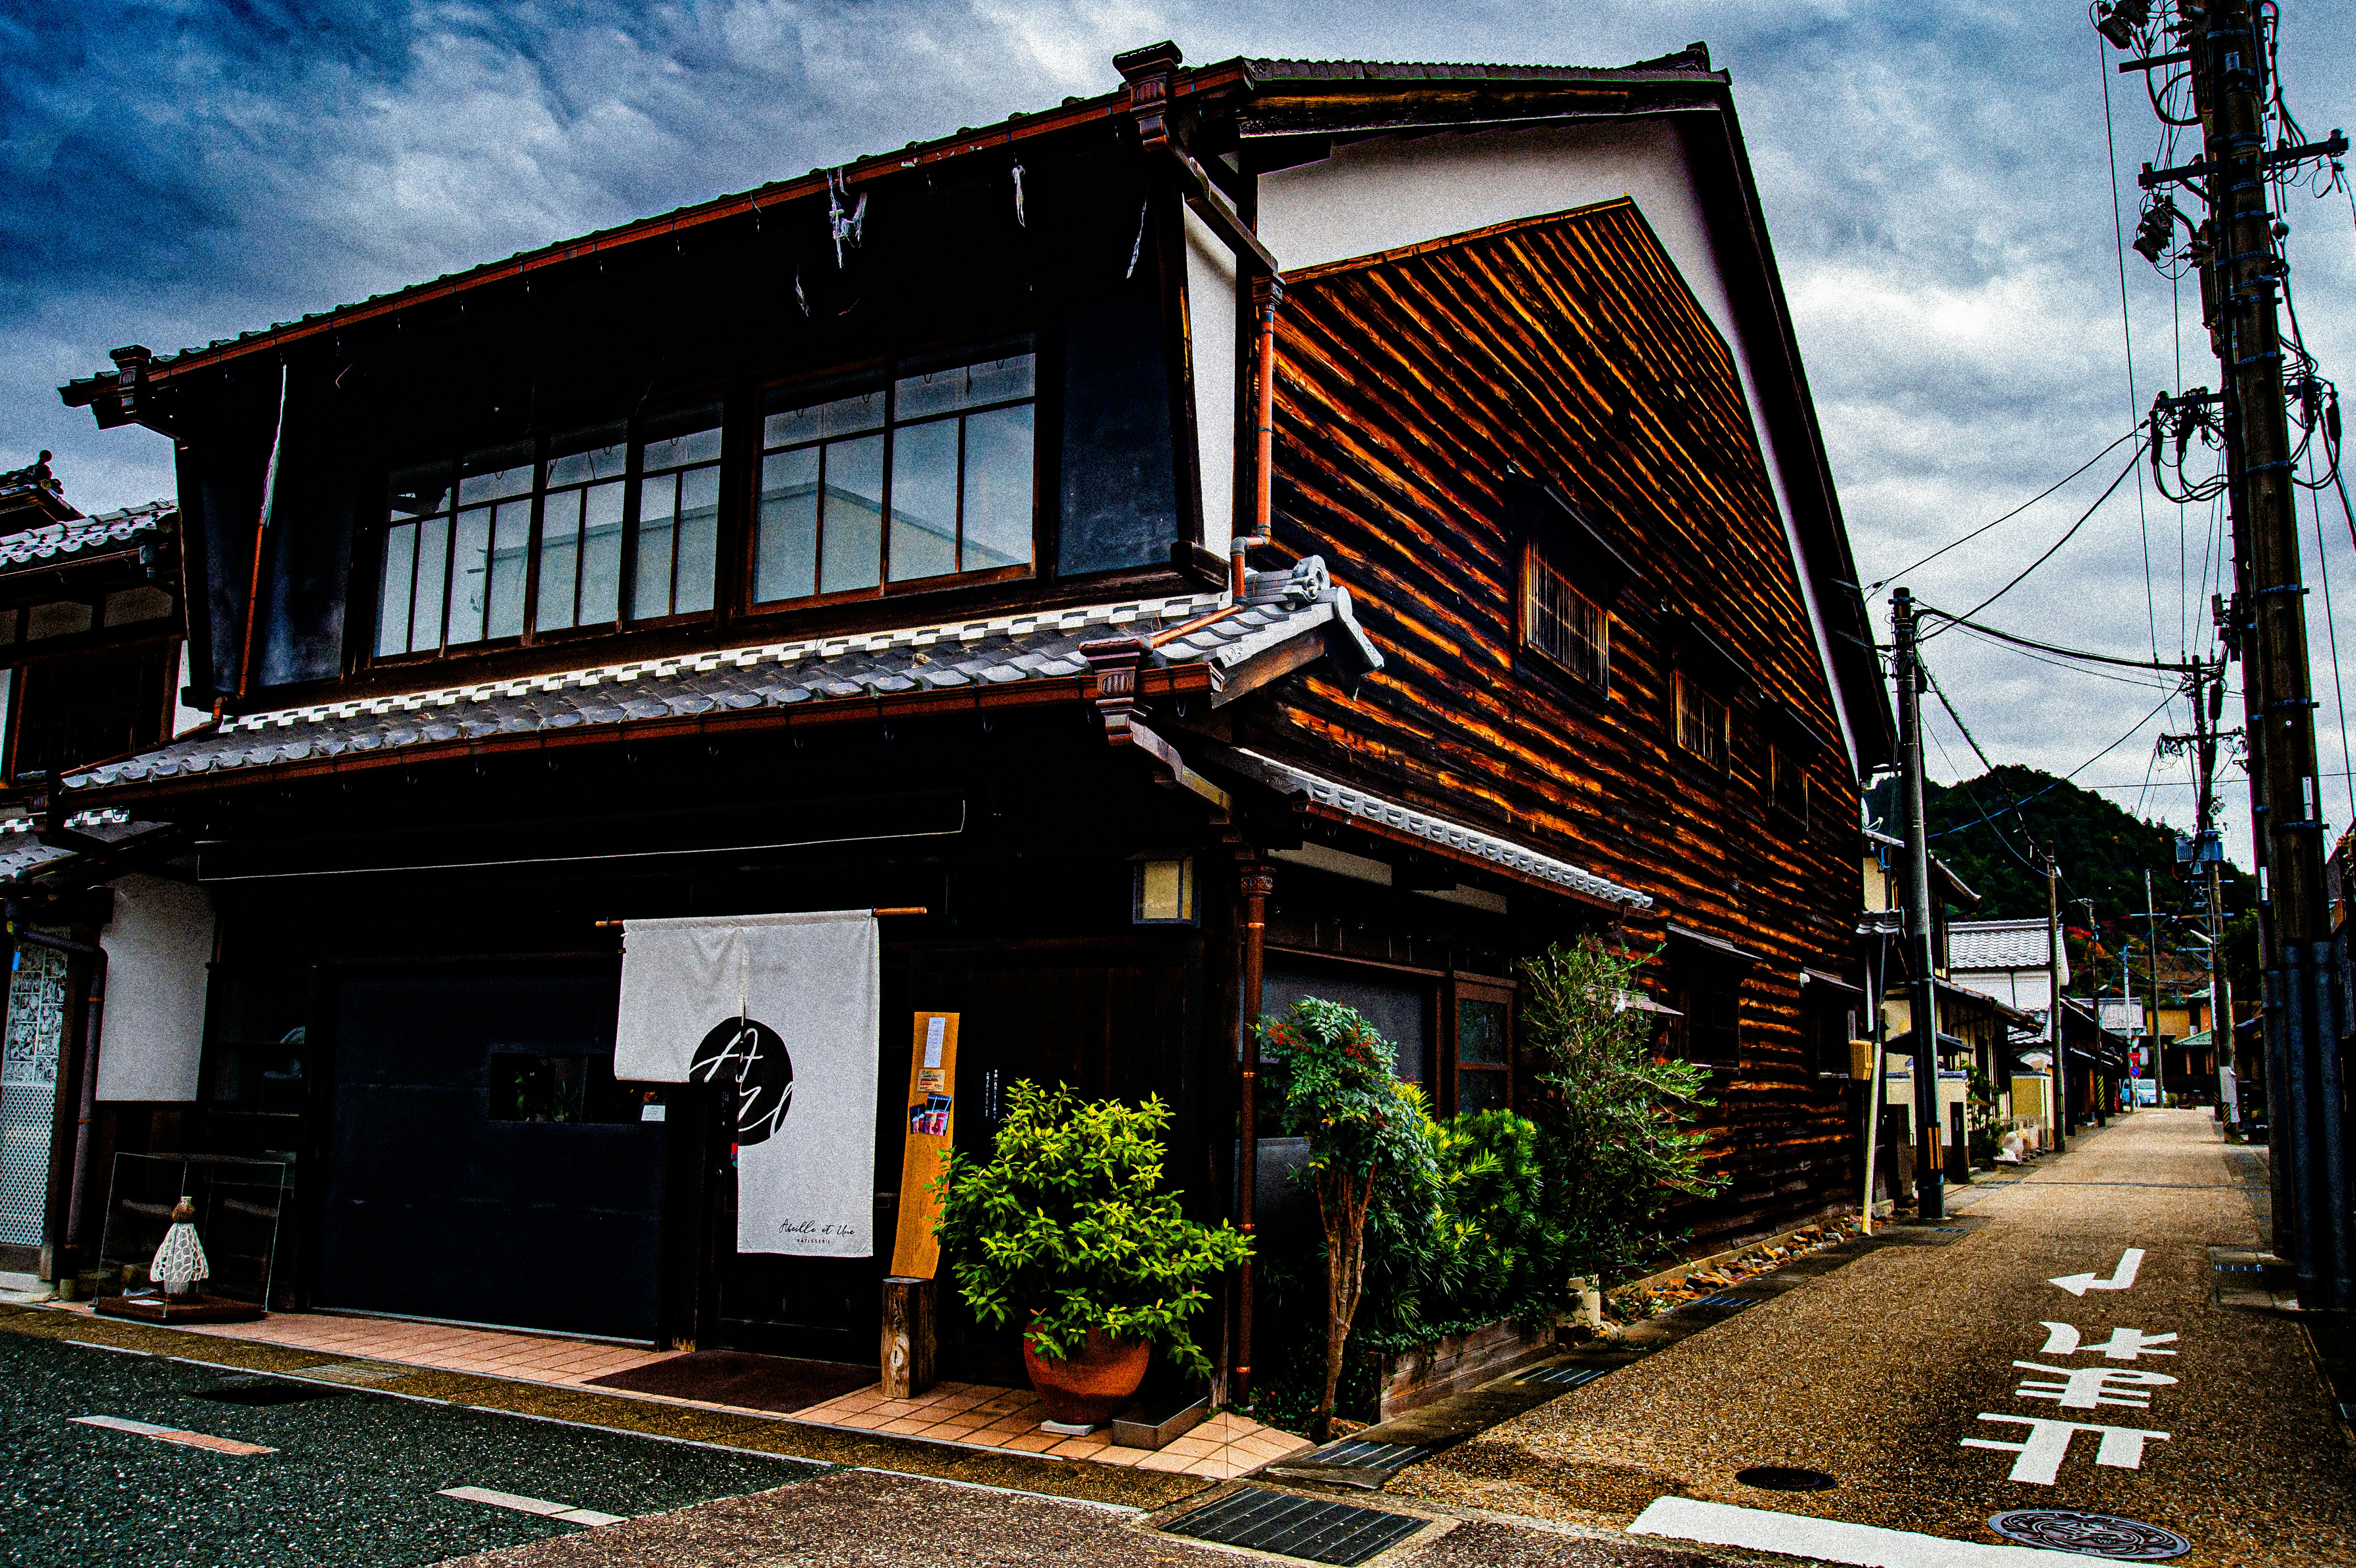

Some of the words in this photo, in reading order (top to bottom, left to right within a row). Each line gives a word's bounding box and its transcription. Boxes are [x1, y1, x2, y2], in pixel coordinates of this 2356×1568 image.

[779, 1219, 817, 1233] Abeille
[821, 1224, 834, 1235] et
[837, 1224, 855, 1238] Une
[1960, 1321, 2179, 1486] 止まれ
